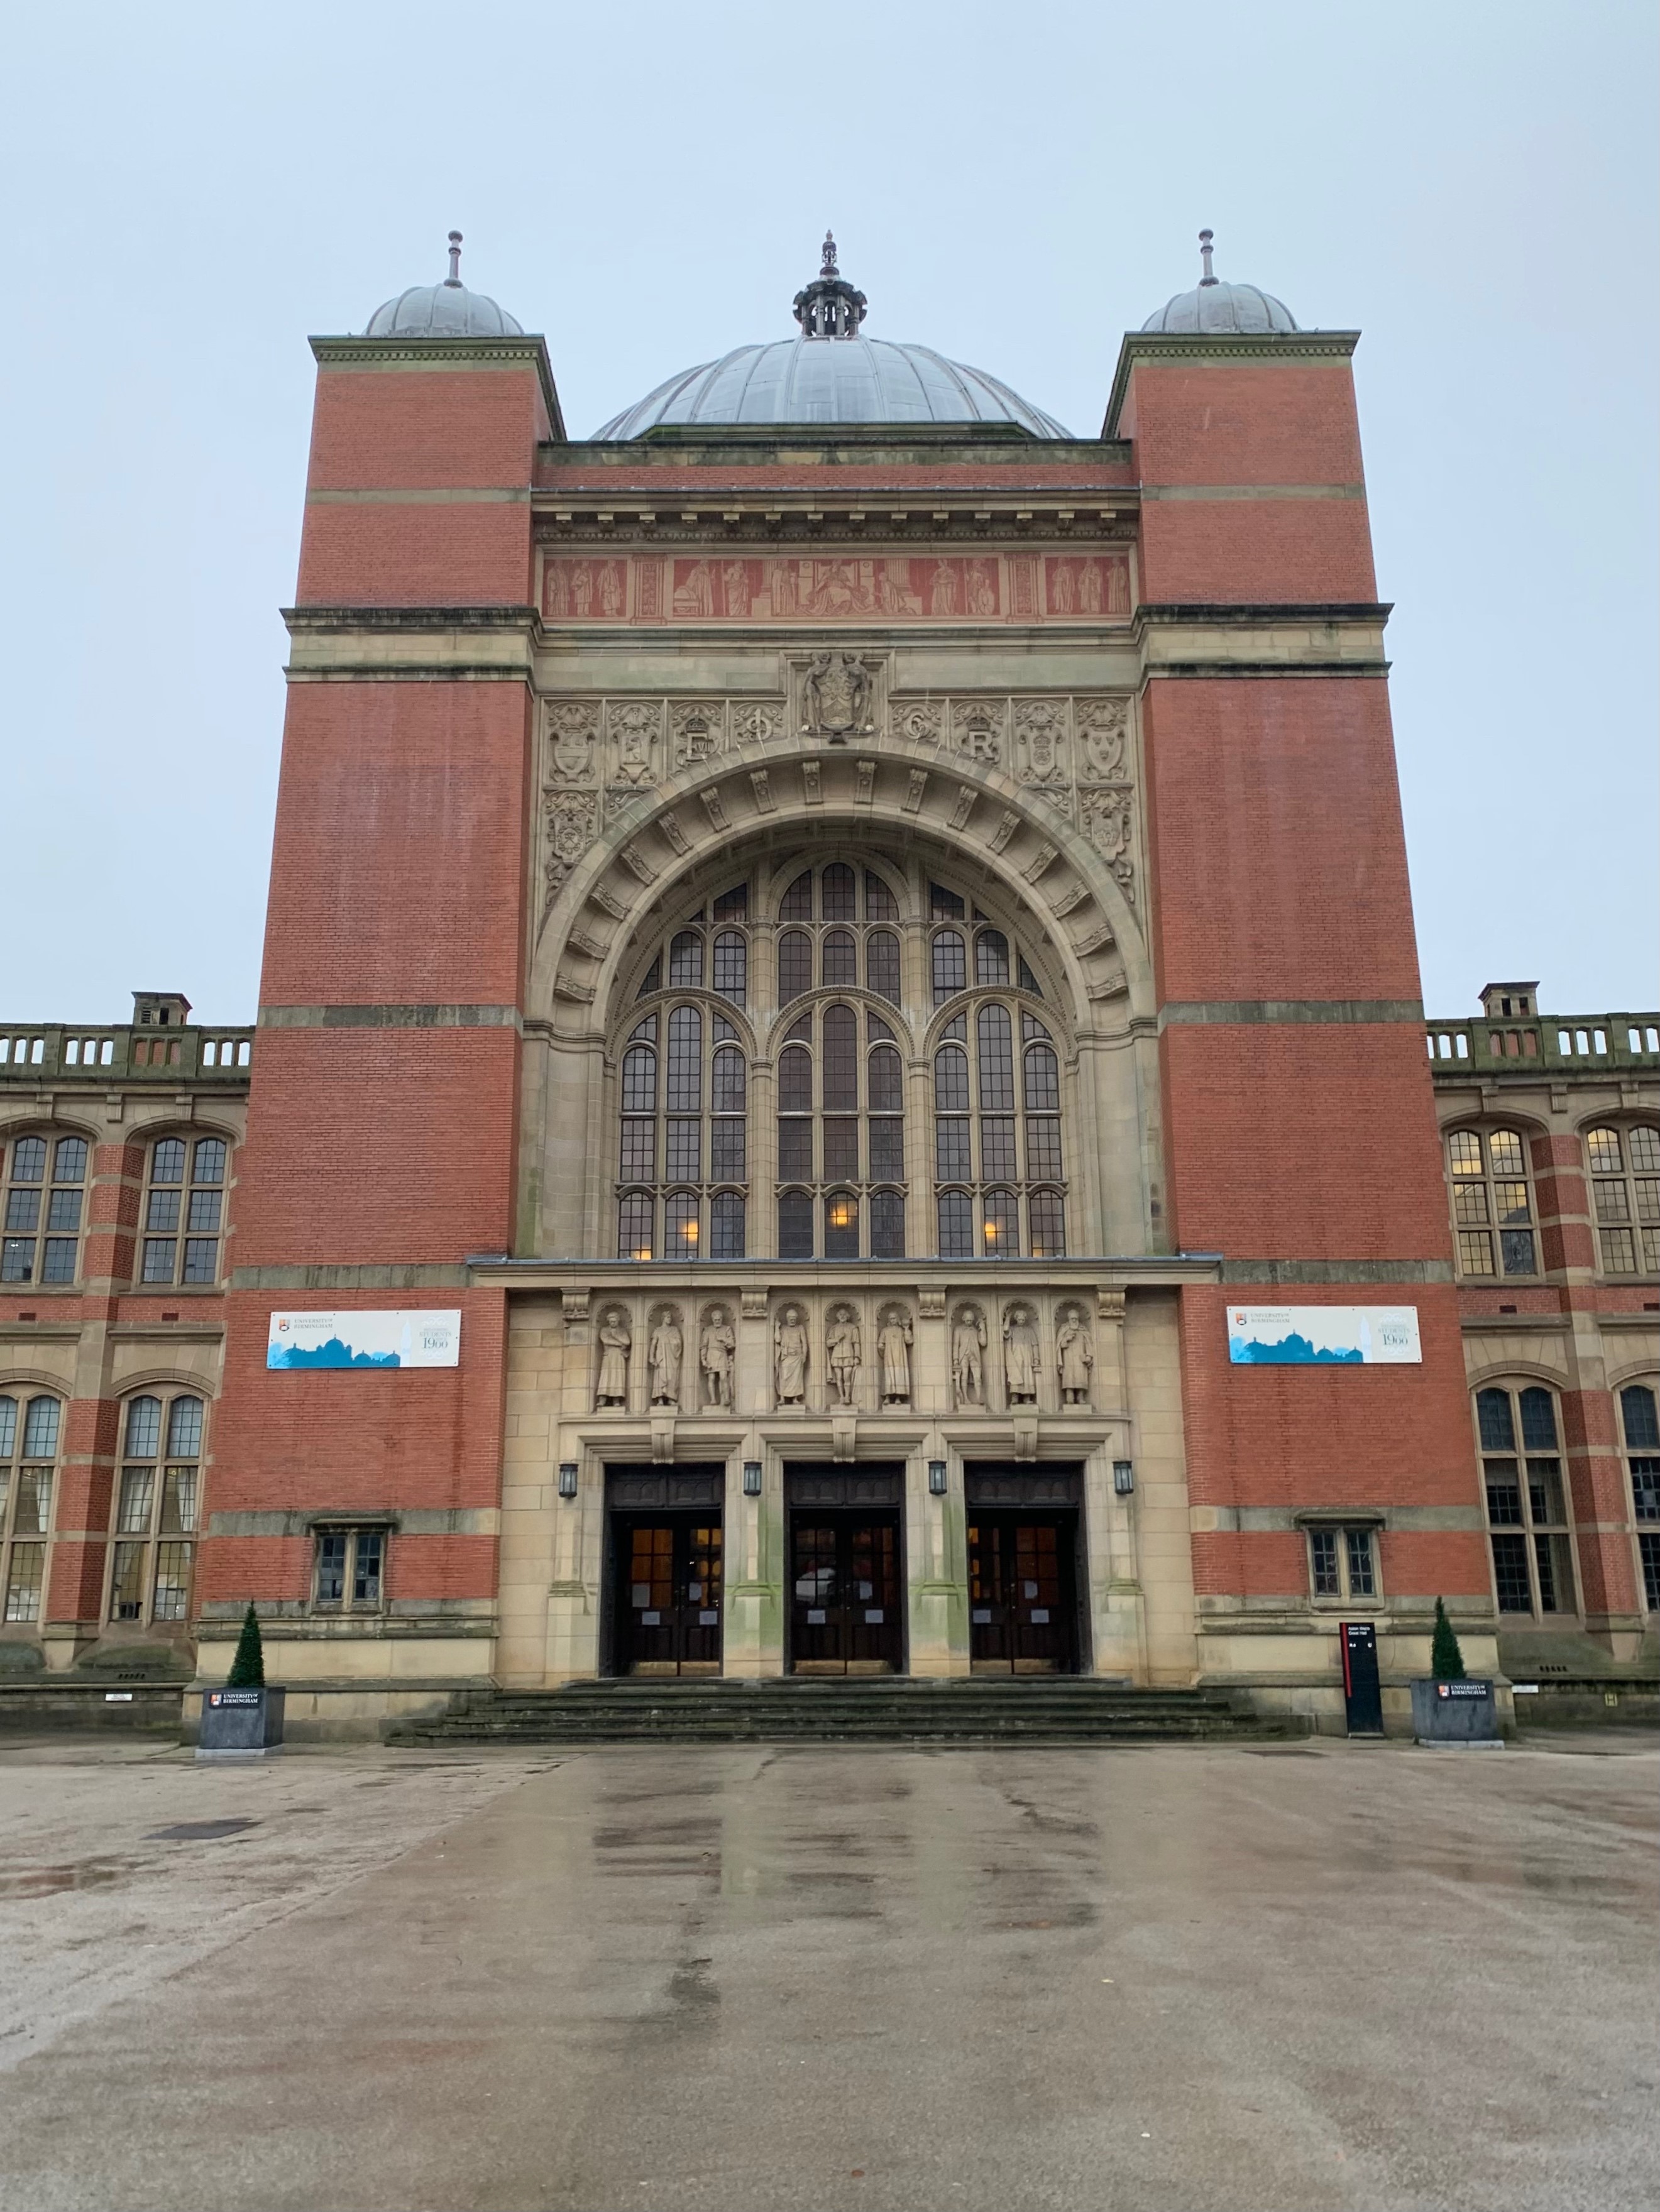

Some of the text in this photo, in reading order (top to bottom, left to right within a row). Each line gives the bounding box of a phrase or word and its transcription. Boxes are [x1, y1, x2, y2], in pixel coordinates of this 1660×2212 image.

[969, 731, 995, 758] R
[423, 1337, 448, 1349] 1900
[1383, 1333, 1409, 1345] 1900
